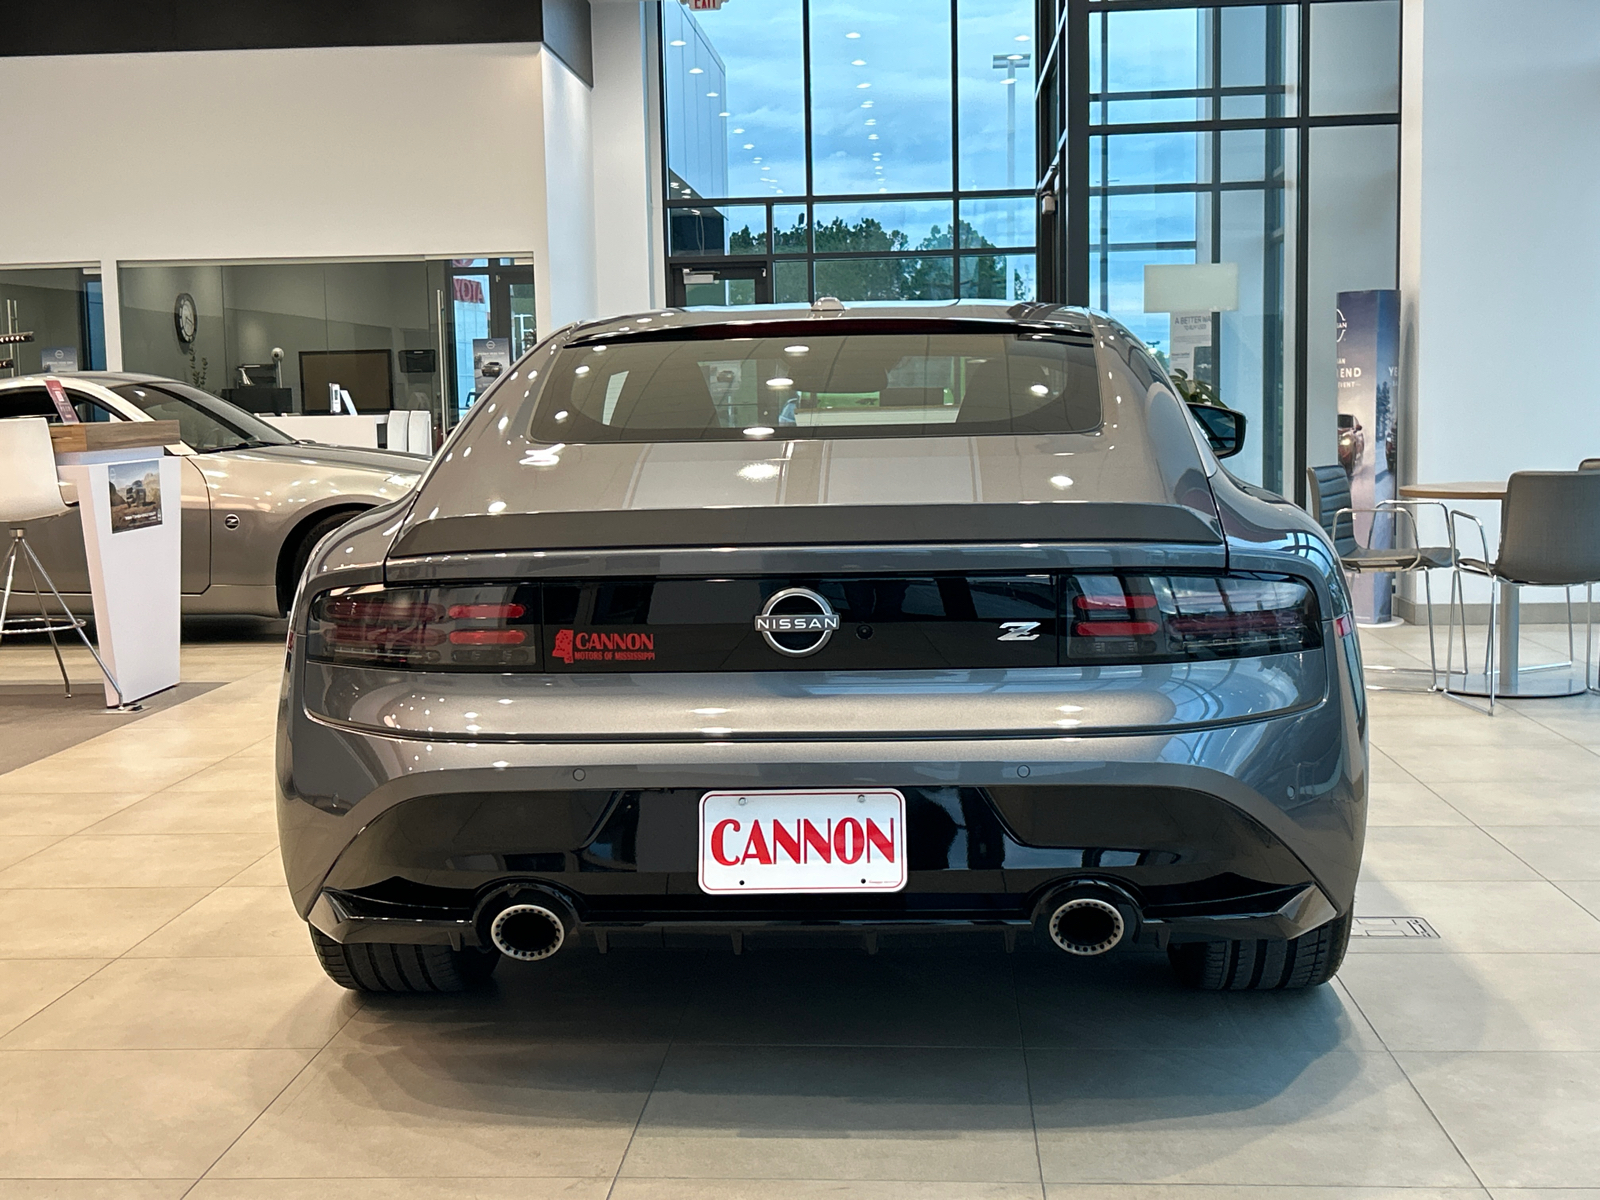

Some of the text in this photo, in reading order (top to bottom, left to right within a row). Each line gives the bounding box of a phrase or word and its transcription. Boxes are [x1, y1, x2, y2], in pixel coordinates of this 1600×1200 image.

[1180, 315, 1202, 325] BETTER
[1337, 367, 1362, 378] END
[757, 617, 837, 630] NISSAN
[997, 621, 1041, 641] Z
[575, 632, 654, 650] CANNON
[574, 651, 656, 661] MOTORS OF MISSISSIPPI
[710, 816, 895, 867] CANNON
